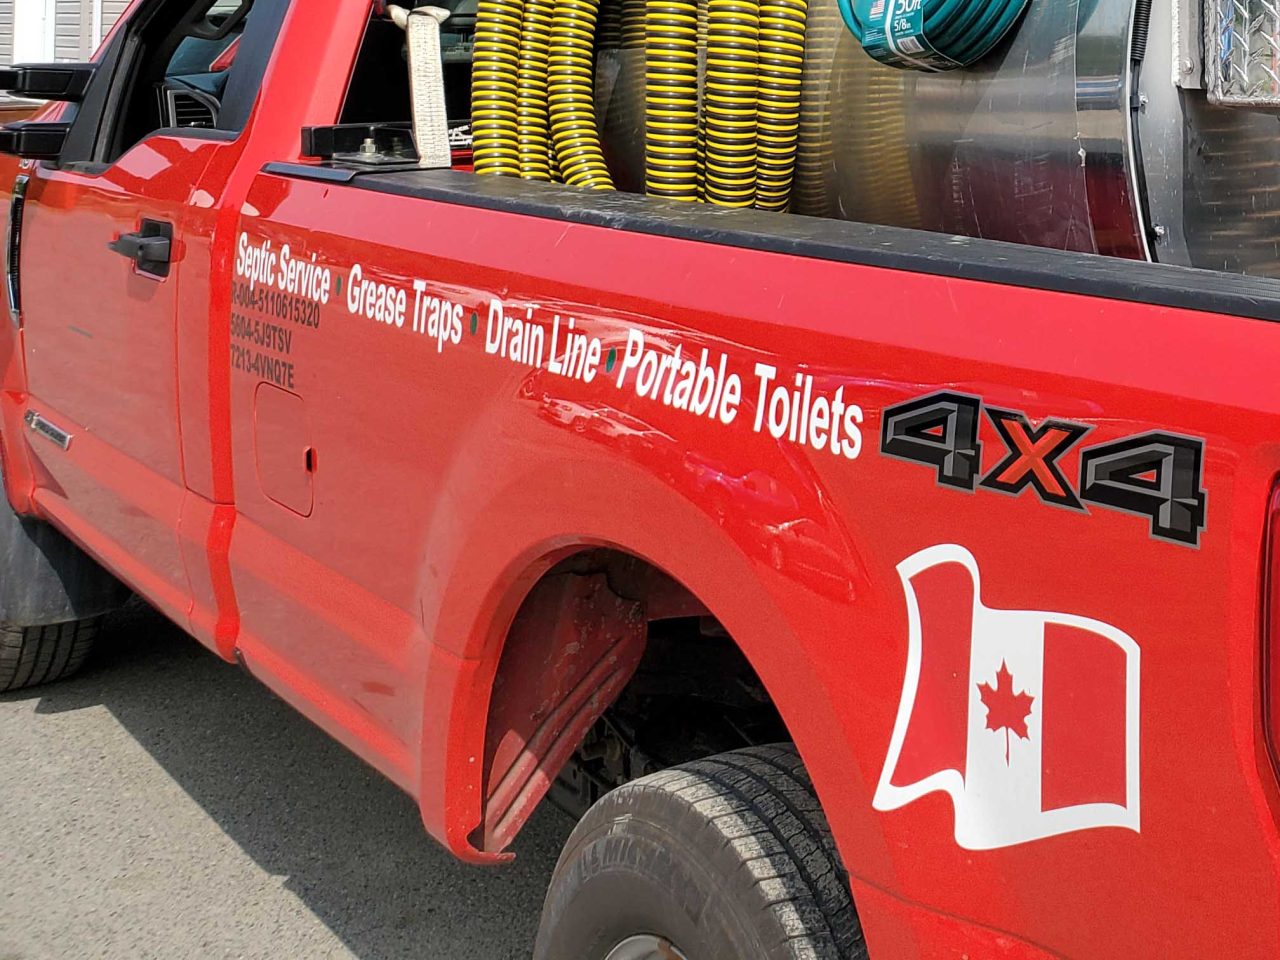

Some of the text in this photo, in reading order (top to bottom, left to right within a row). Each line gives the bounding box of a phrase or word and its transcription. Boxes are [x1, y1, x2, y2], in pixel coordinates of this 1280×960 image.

[236, 231, 864, 460] Septic Service Grease Traps Drain Line Portable Toilets
[879, 389, 1208, 550] 4X4
